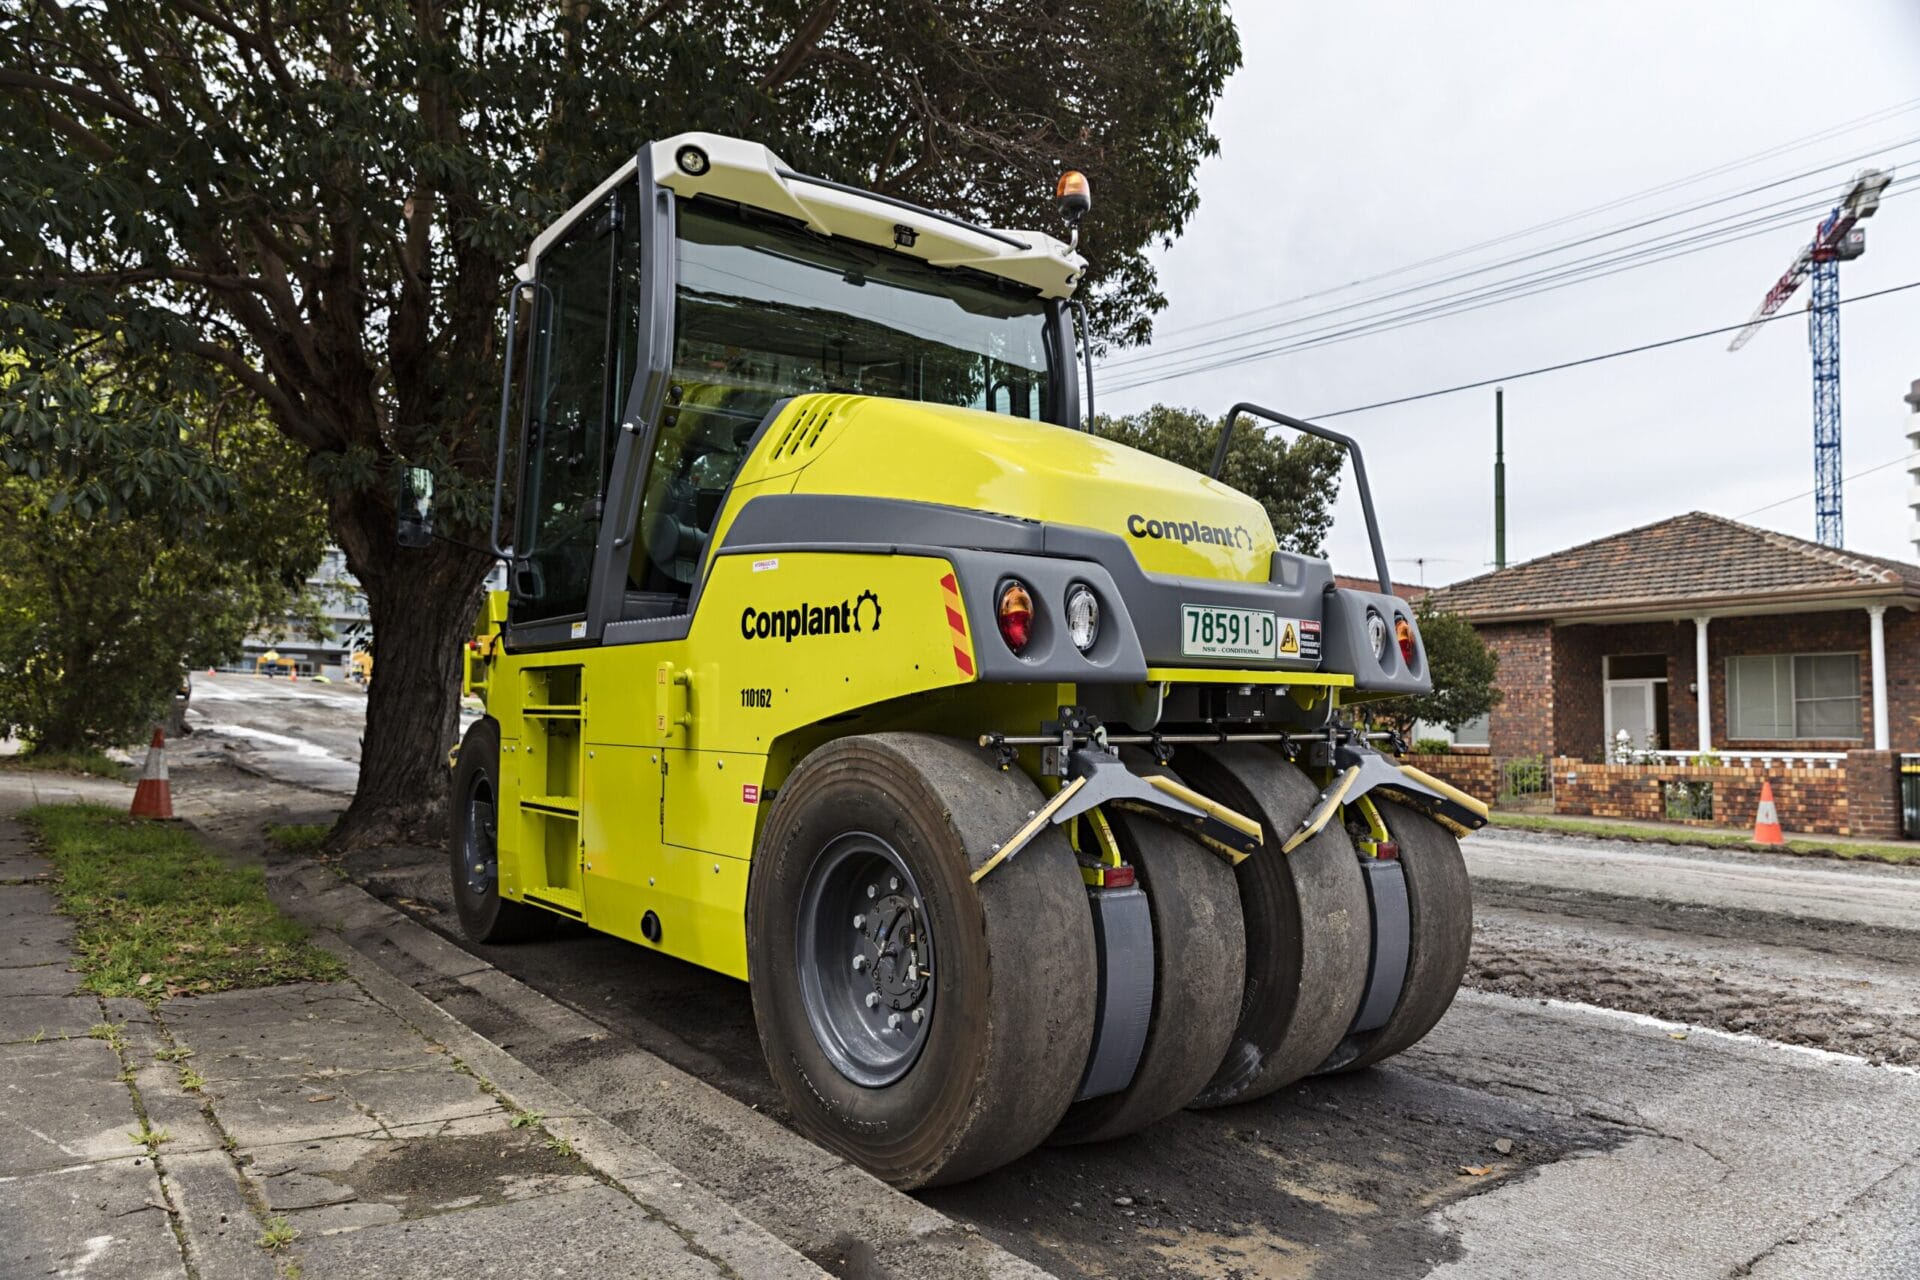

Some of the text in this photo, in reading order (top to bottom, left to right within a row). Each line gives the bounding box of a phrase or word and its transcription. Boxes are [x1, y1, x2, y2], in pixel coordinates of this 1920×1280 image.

[1127, 514, 1235, 548] Conplant
[741, 599, 850, 643] Conplant
[1221, 647, 1261, 655] CONDITIONAL
[740, 688, 772, 709] 110162
